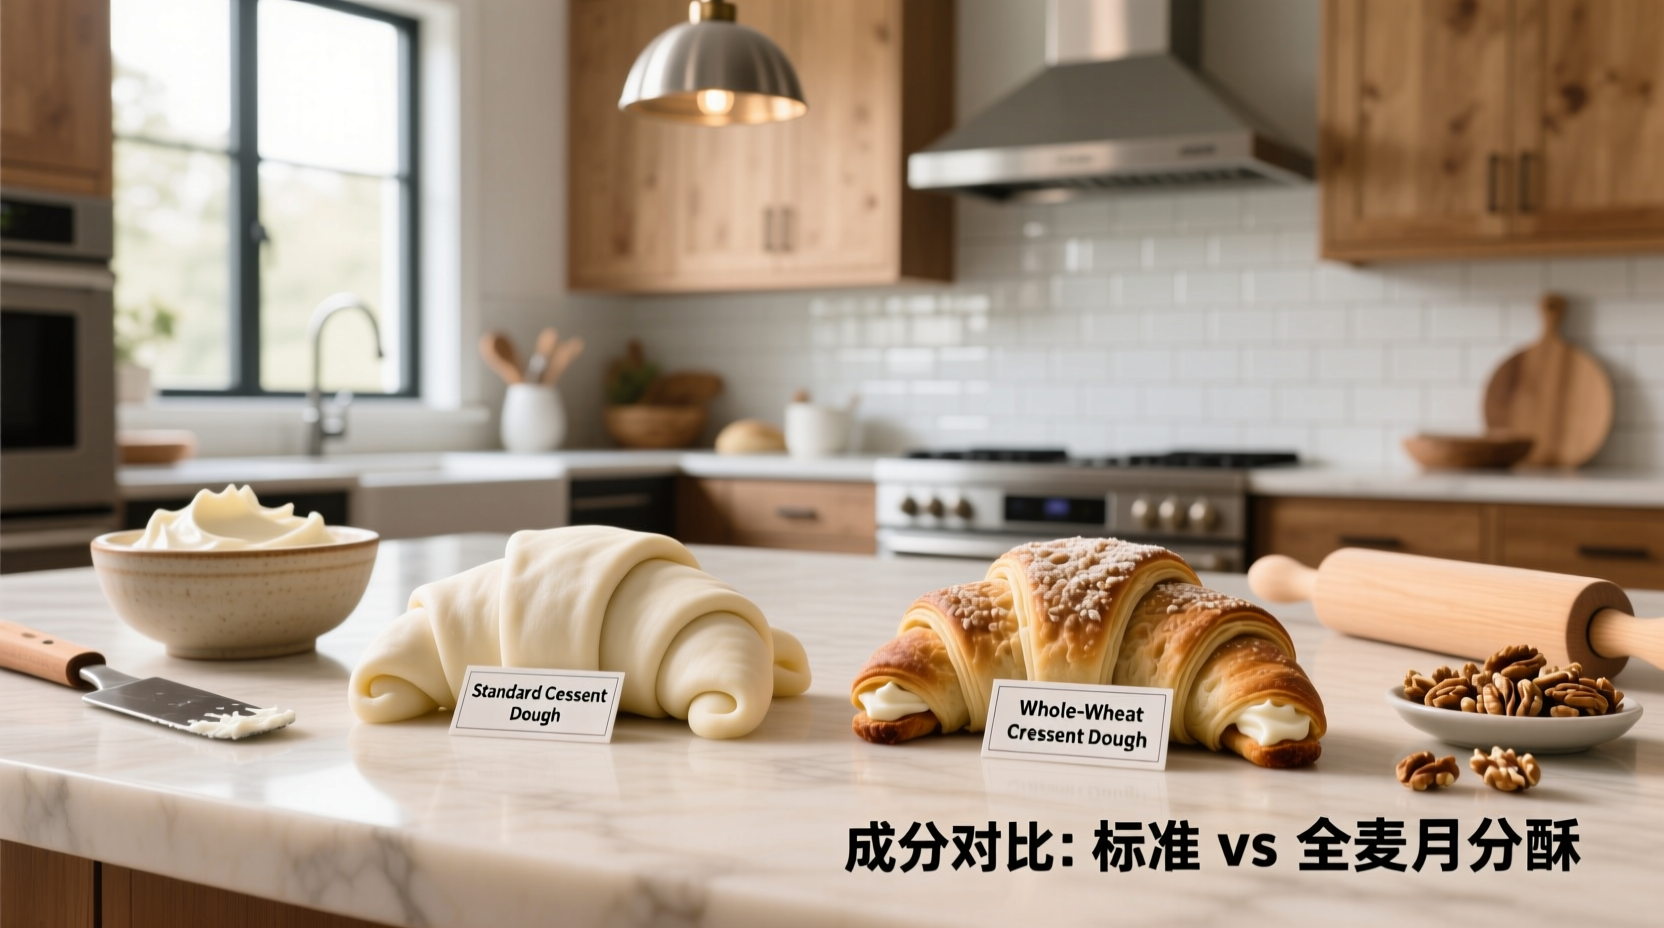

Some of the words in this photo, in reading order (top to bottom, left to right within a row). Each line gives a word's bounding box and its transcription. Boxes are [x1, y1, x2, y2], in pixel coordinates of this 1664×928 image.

[472, 683, 543, 701] Standard
[545, 686, 608, 703] Cessent
[509, 706, 561, 726] Dough
[1020, 699, 1145, 722] Whole-Wheat
[1007, 723, 1084, 744] Cressent
[1088, 729, 1147, 751] Dough
